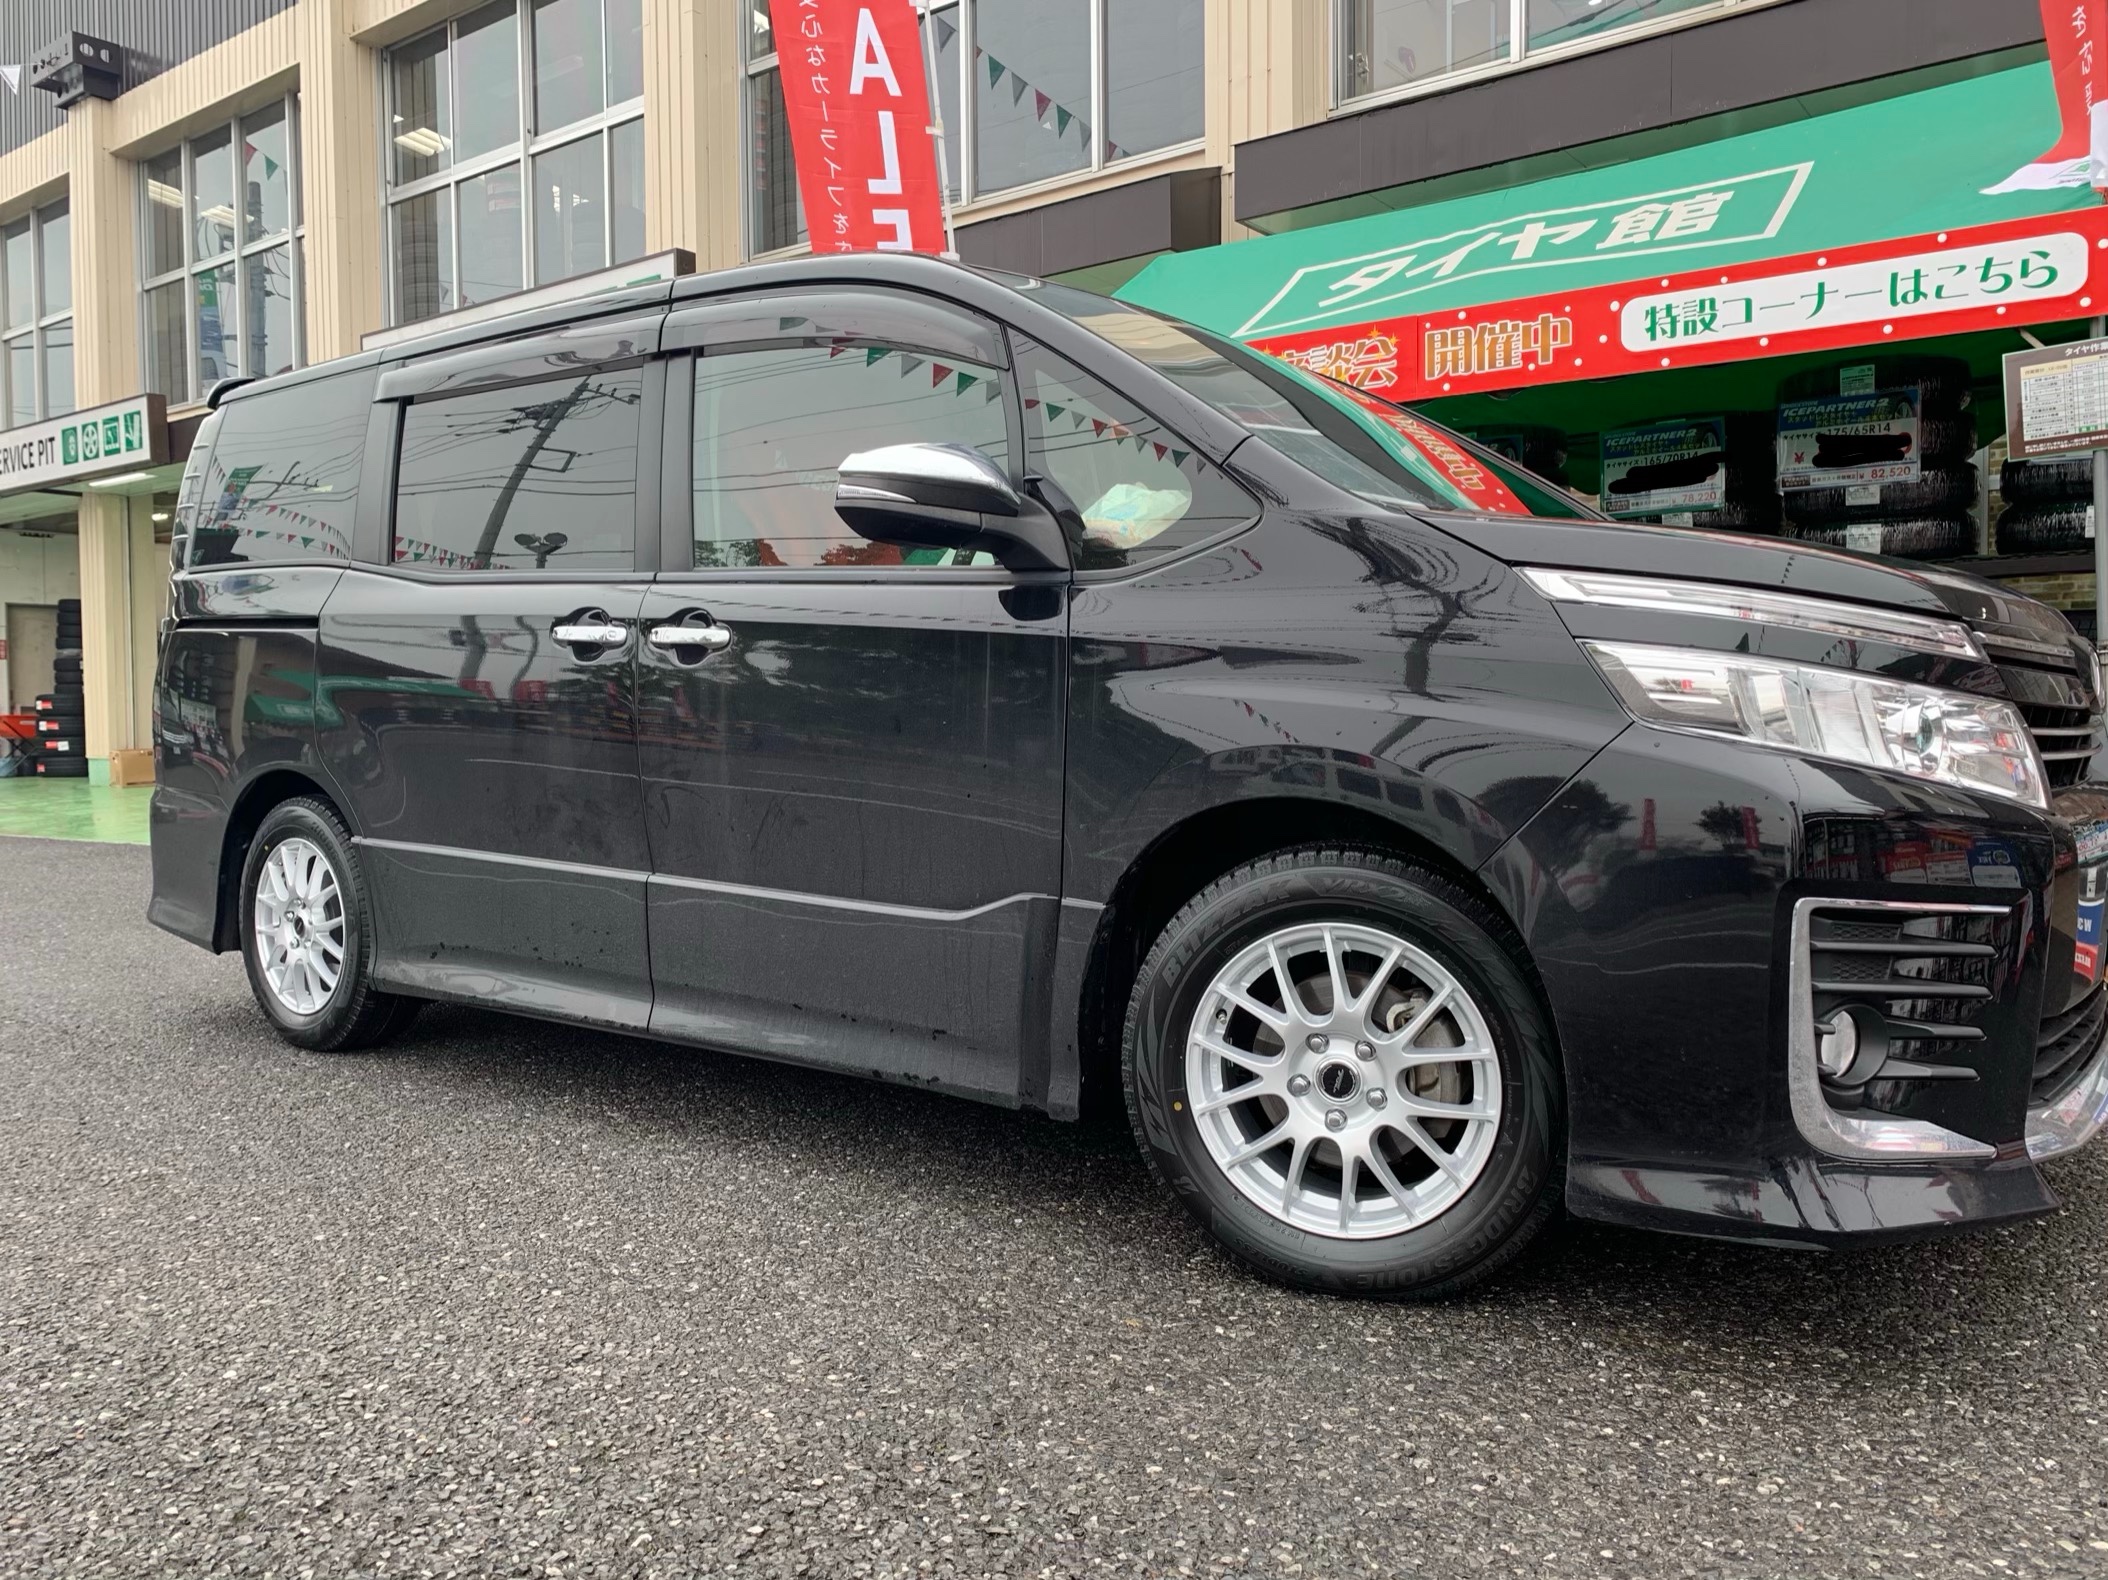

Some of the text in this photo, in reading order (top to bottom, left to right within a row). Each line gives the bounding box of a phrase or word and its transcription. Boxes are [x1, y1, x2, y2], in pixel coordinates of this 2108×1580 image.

[1319, 191, 1734, 307] タイヤ館
[1424, 314, 1573, 381] 開催中
[1644, 250, 2059, 342] 特設コーナーはこちら
[38, 436, 55, 467] PIT
[1871, 466, 1911, 479] 82,520
[1682, 491, 1717, 505] 78,220
[1162, 878, 1294, 987] BLIZZAK
